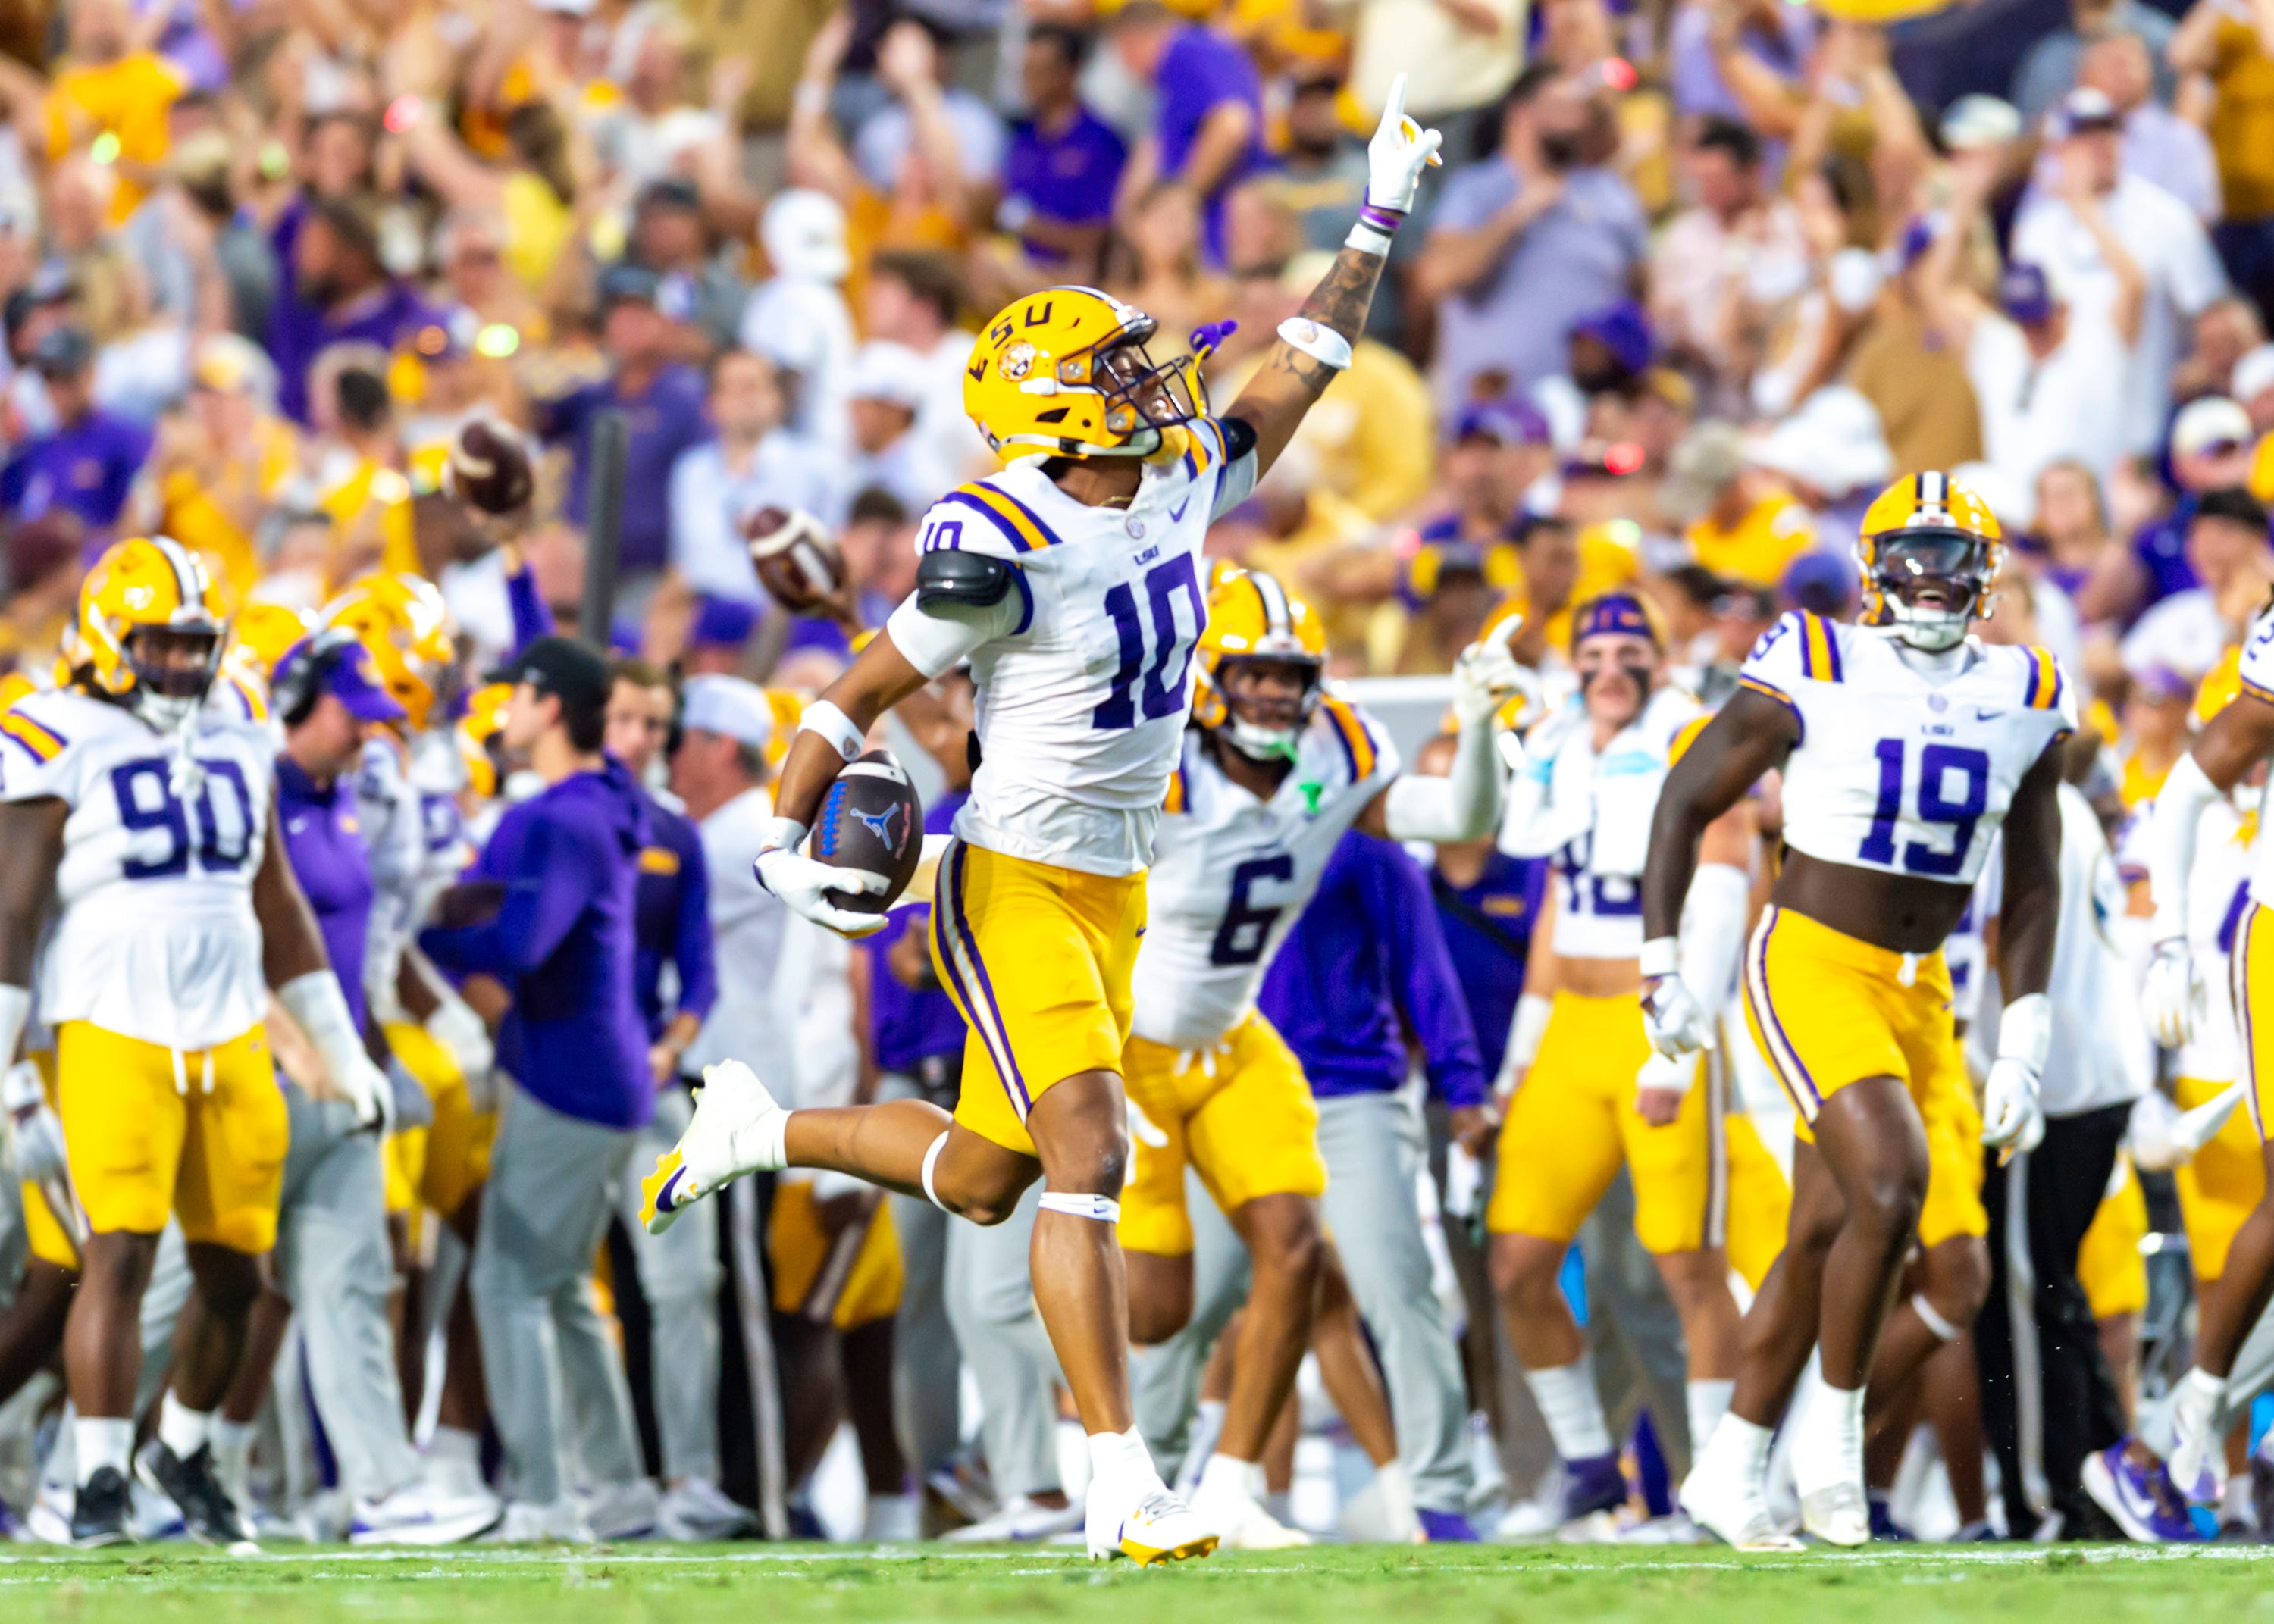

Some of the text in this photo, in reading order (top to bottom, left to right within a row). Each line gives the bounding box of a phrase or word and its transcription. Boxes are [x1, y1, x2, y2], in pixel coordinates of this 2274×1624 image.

[968, 301, 1054, 383] LSU
[1134, 545, 1159, 565] LSU
[1092, 550, 1207, 729] 10
[111, 756, 255, 880] 90
[1858, 738, 1990, 875] 19
[1210, 853, 1294, 965] 6
